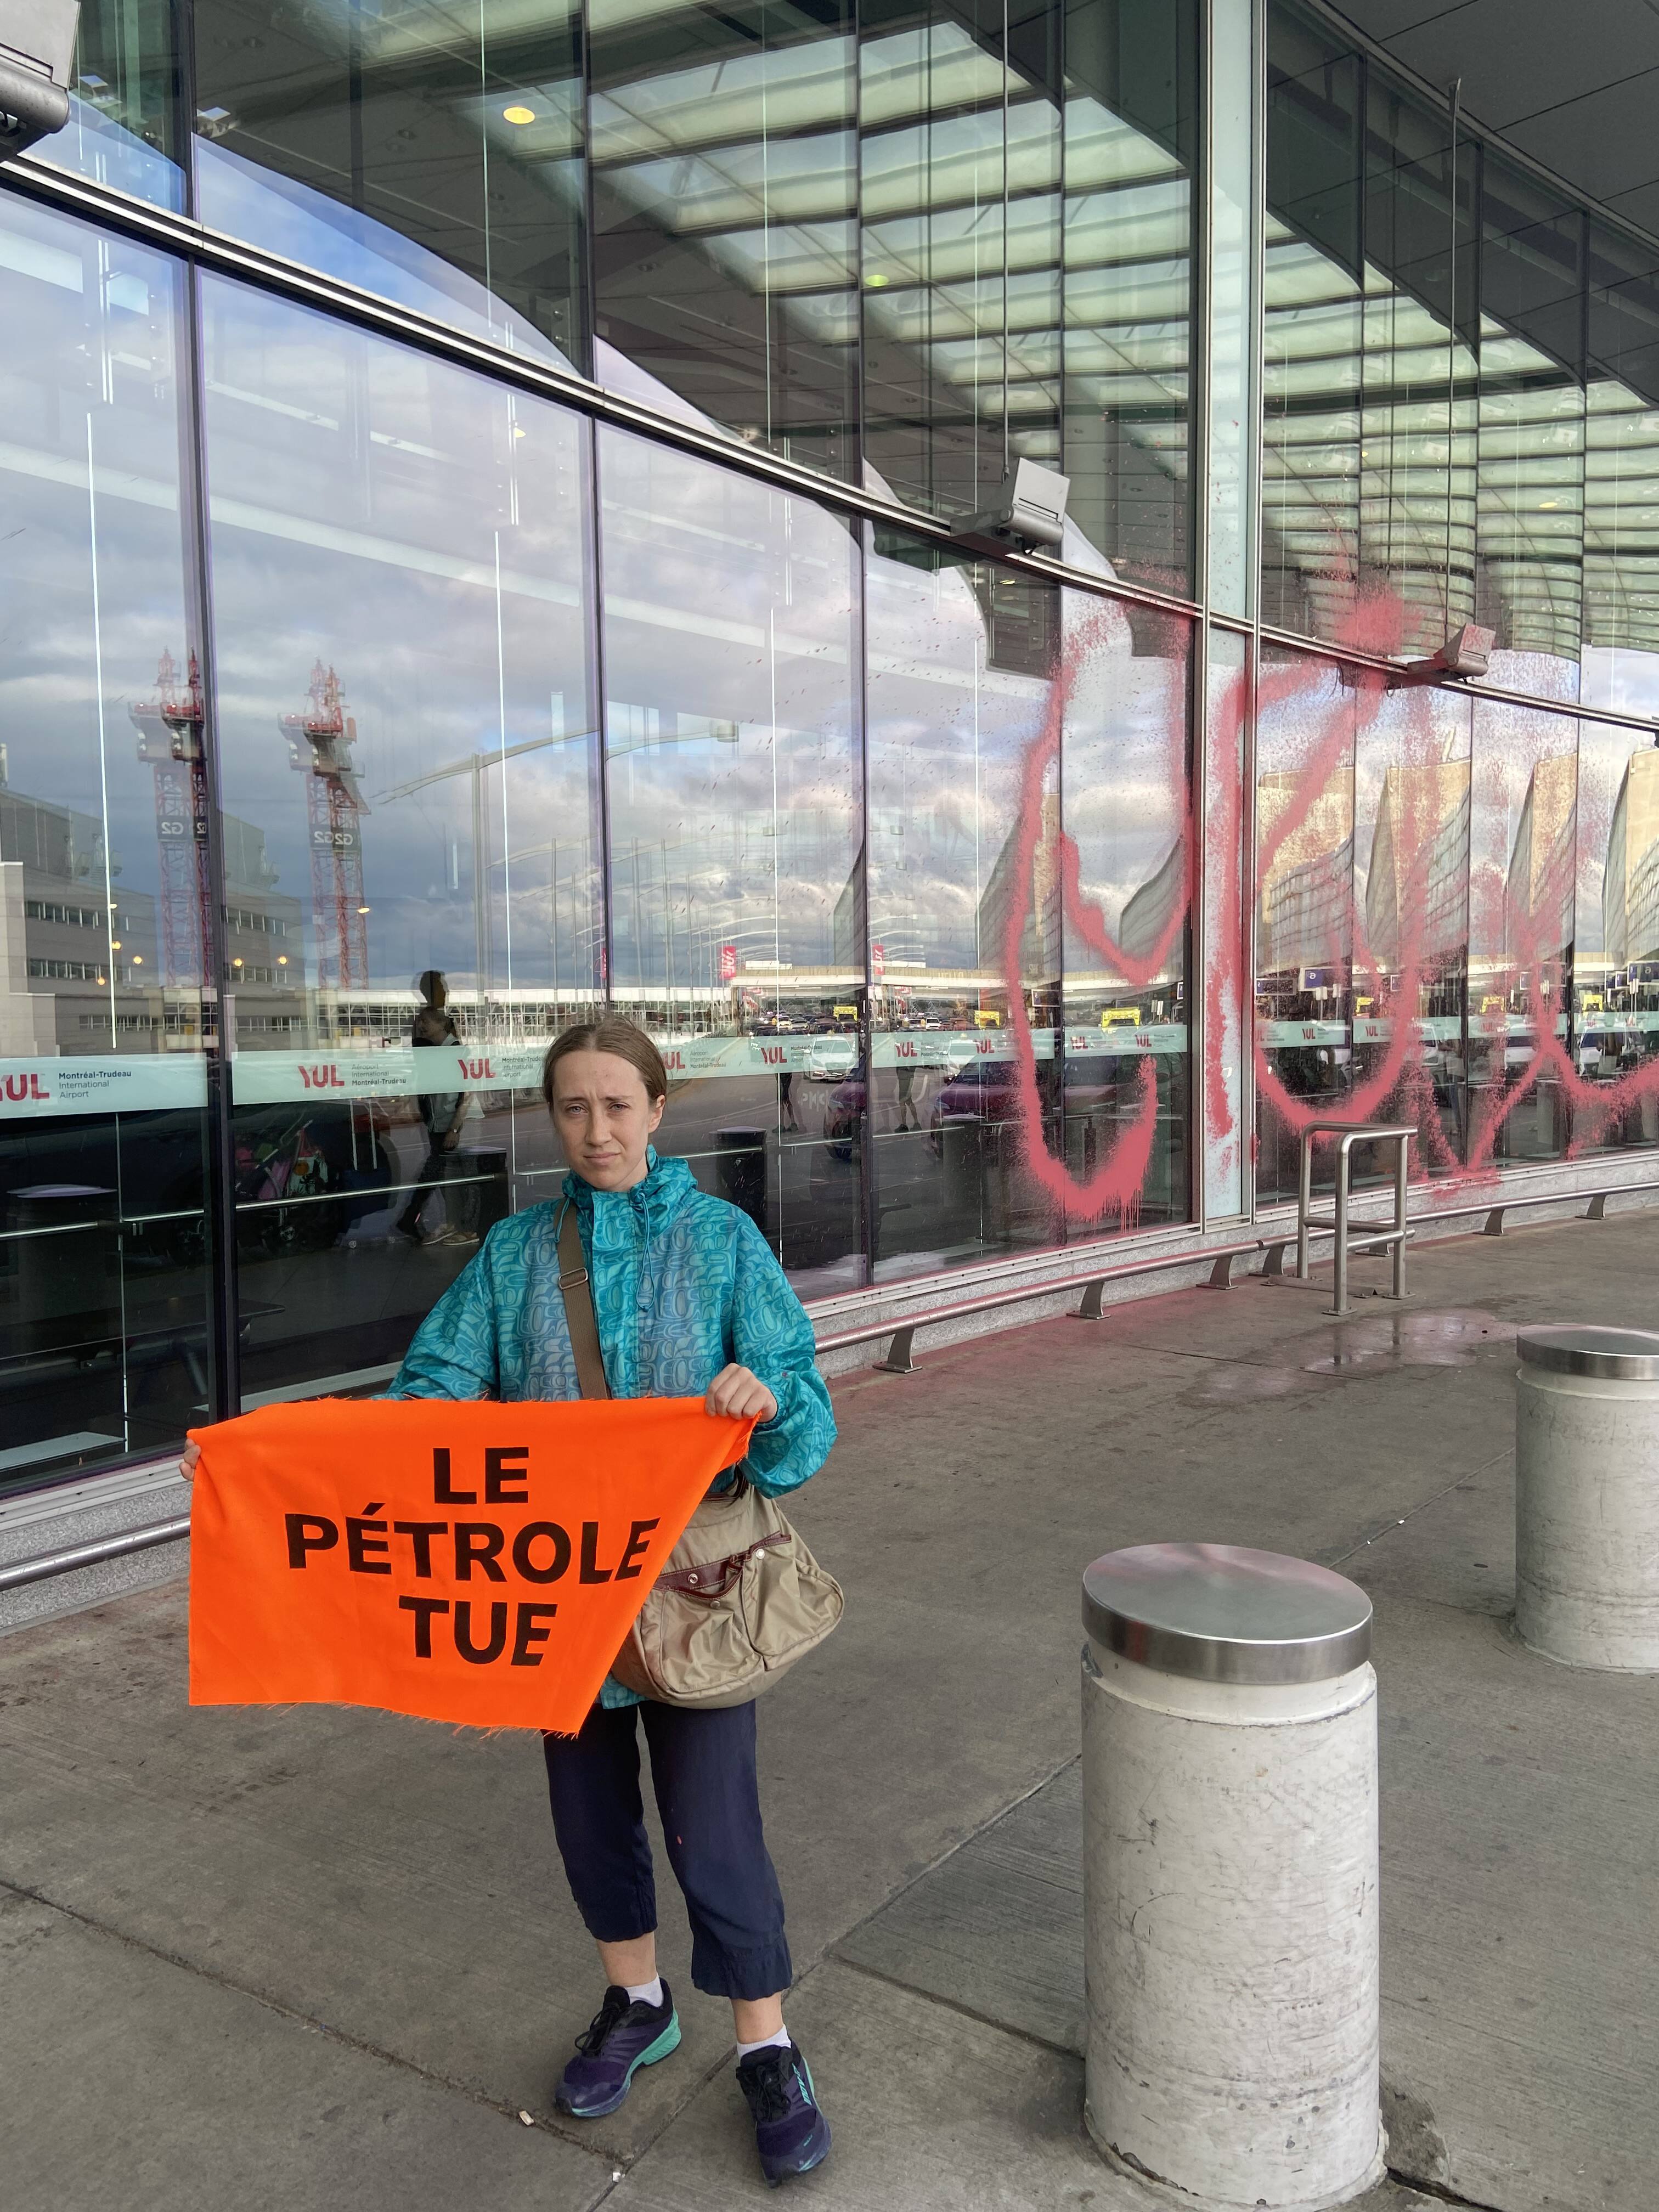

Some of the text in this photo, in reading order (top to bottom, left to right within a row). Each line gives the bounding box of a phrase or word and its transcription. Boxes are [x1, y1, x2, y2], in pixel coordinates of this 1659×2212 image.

[1302, 1028, 1316, 1040] YUL
[1365, 1025, 1379, 1036] YUL
[1135, 1034, 1153, 1048] YUL
[760, 1047, 787, 1064] YUL
[895, 1042, 918, 1058] YUL
[664, 1051, 686, 1070] UL
[59, 1070, 132, 1080] Montréal-Trudeau
[298, 1064, 345, 1088] YUL
[458, 1058, 496, 1080] YUL
[59, 1080, 109, 1089] International
[59, 1091, 89, 1099] Airport
[433, 1447, 529, 1505] LE
[285, 1502, 661, 1584] PÉTROLE
[399, 1595, 558, 1667] TUE
